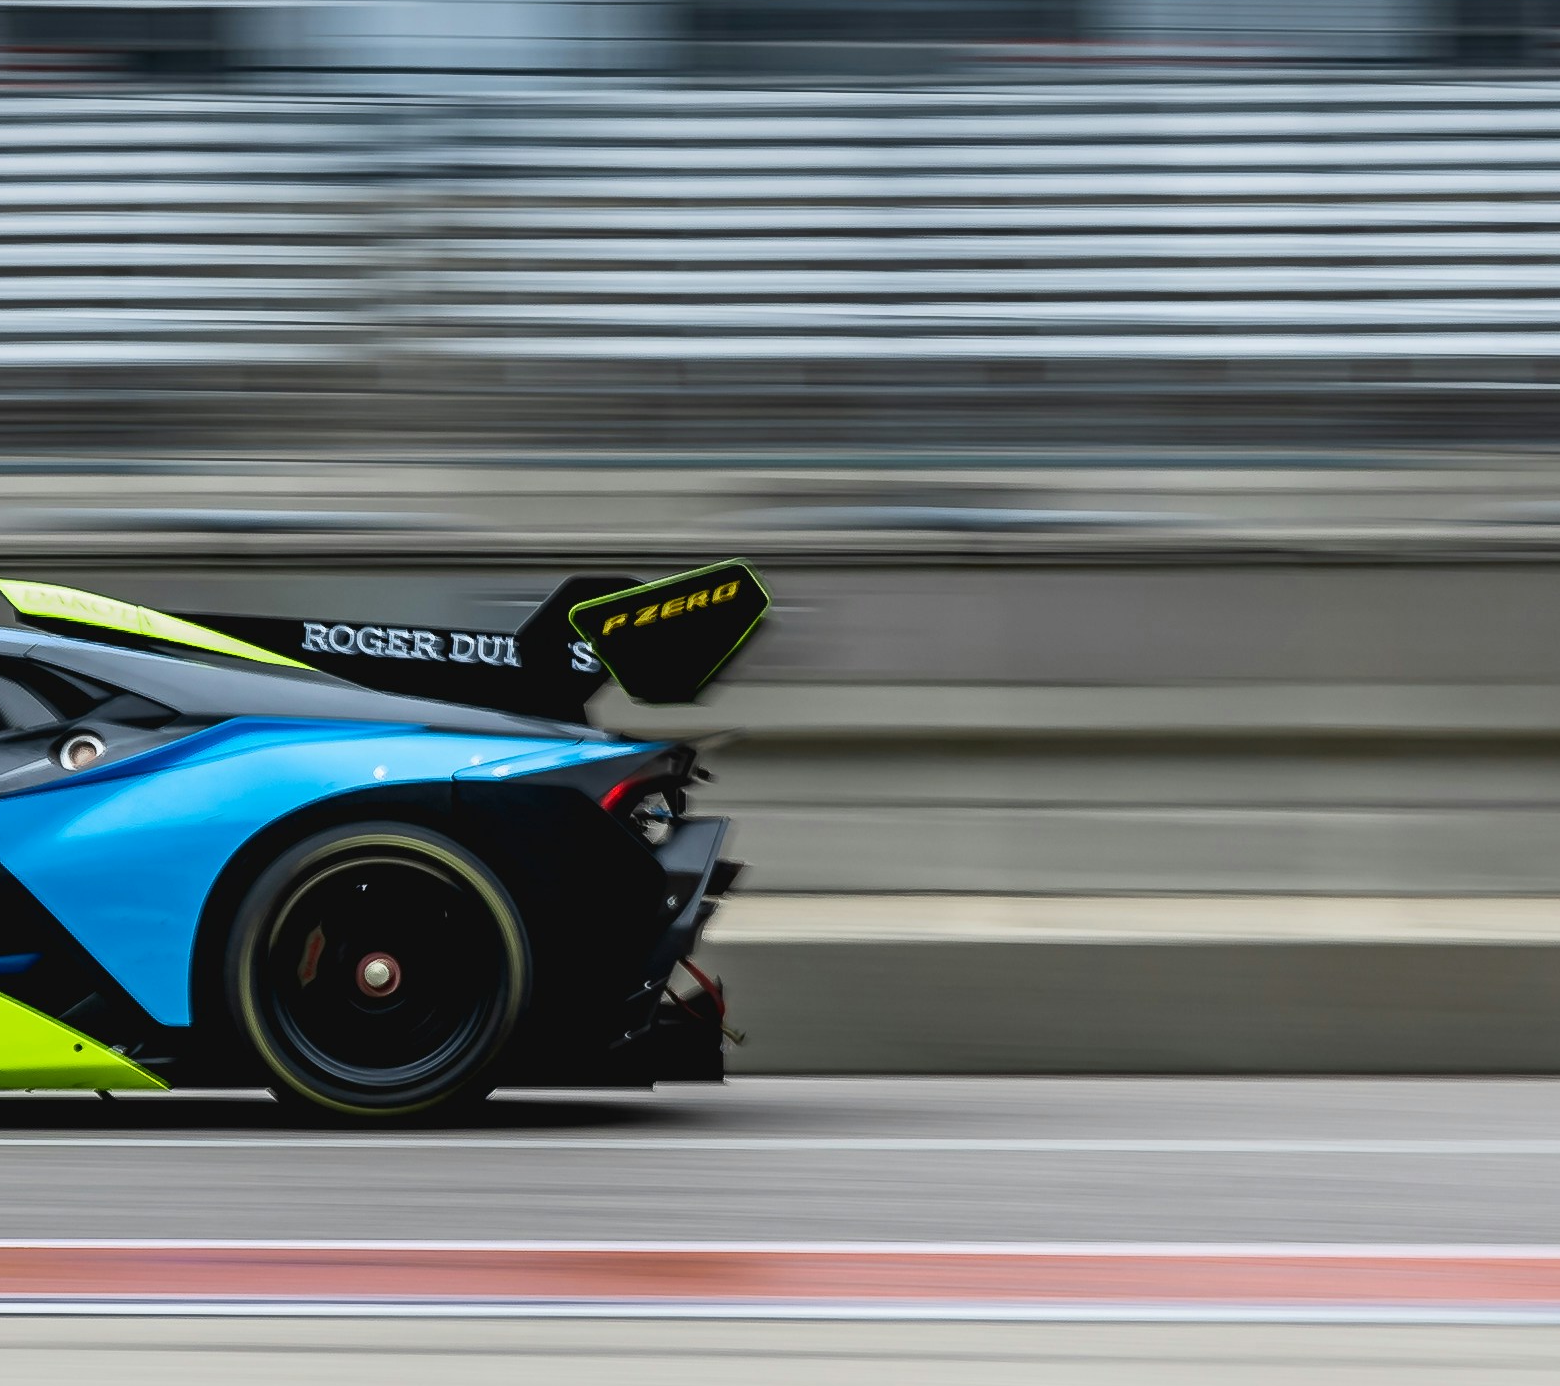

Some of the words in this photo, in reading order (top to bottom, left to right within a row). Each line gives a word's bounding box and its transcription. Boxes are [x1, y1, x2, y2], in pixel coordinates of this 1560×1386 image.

[602, 613, 629, 636] P
[633, 580, 741, 627] ZERO
[301, 621, 447, 662] ROGER
